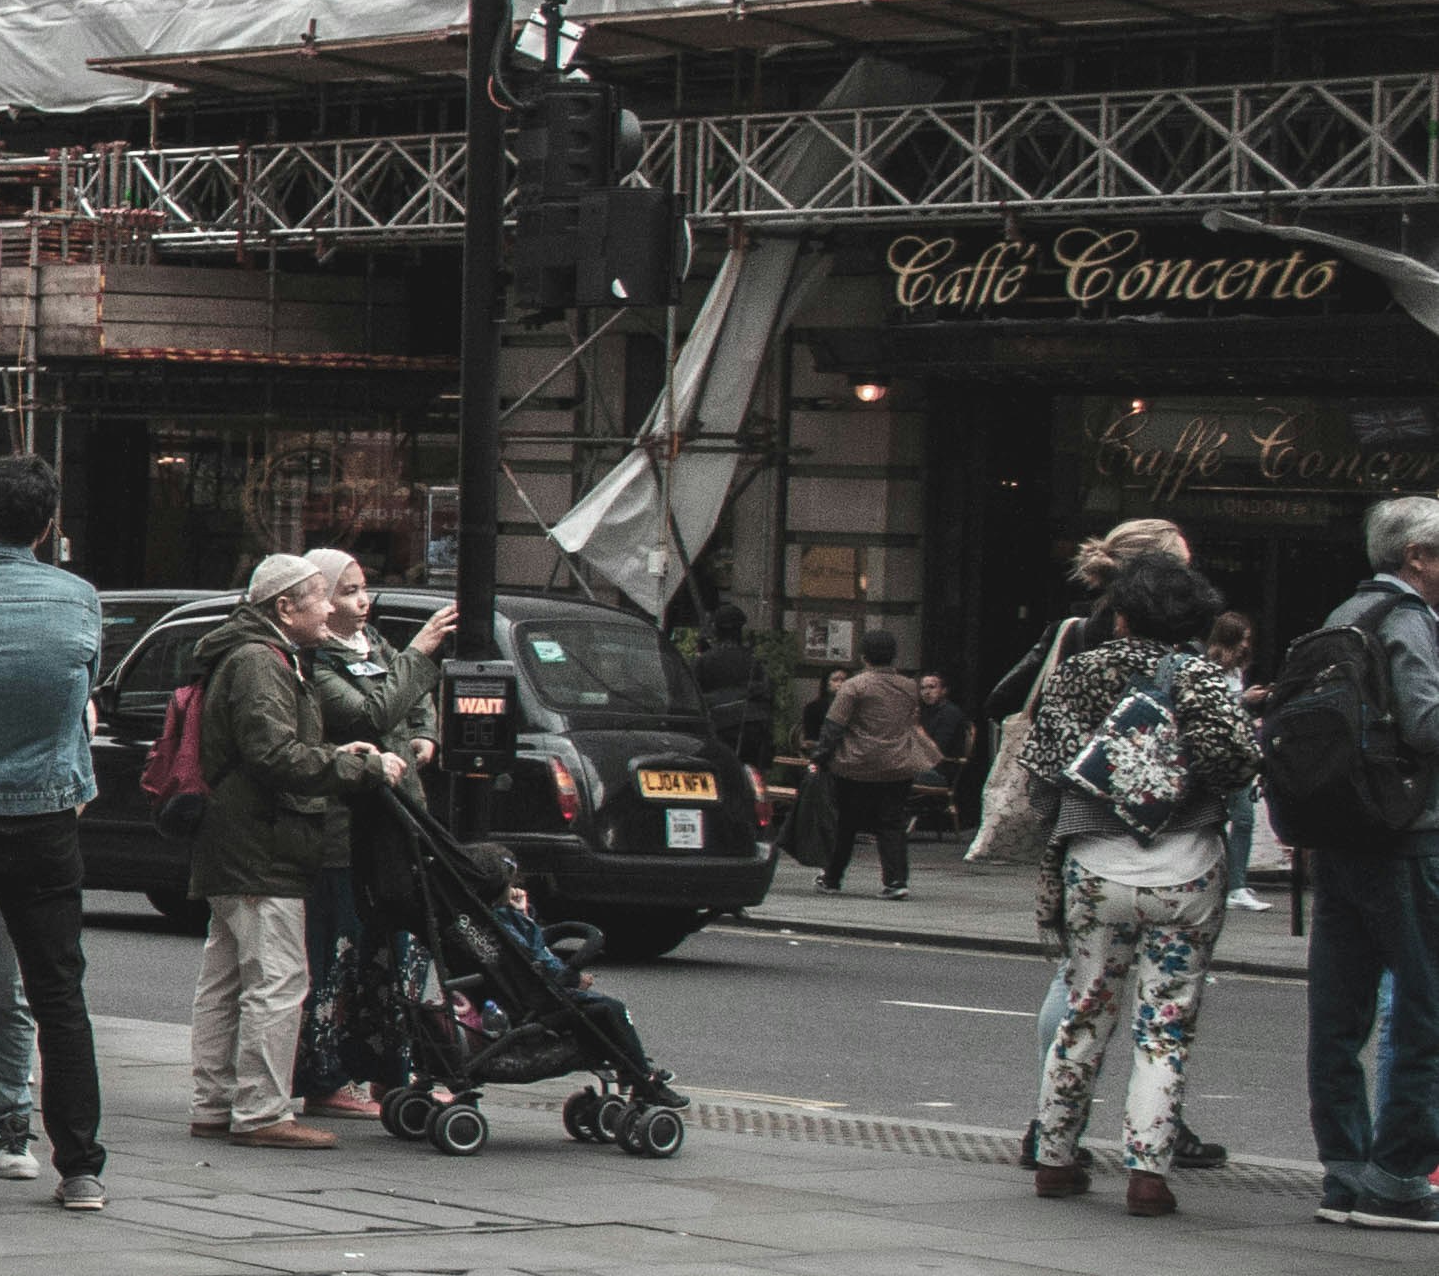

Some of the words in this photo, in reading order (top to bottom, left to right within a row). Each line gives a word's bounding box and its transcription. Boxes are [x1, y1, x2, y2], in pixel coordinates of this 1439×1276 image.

[886, 234, 1037, 311] Caffé
[1054, 227, 1340, 310] Concerto
[1085, 408, 1230, 502] Caffé
[457, 697, 505, 714] WAIT
